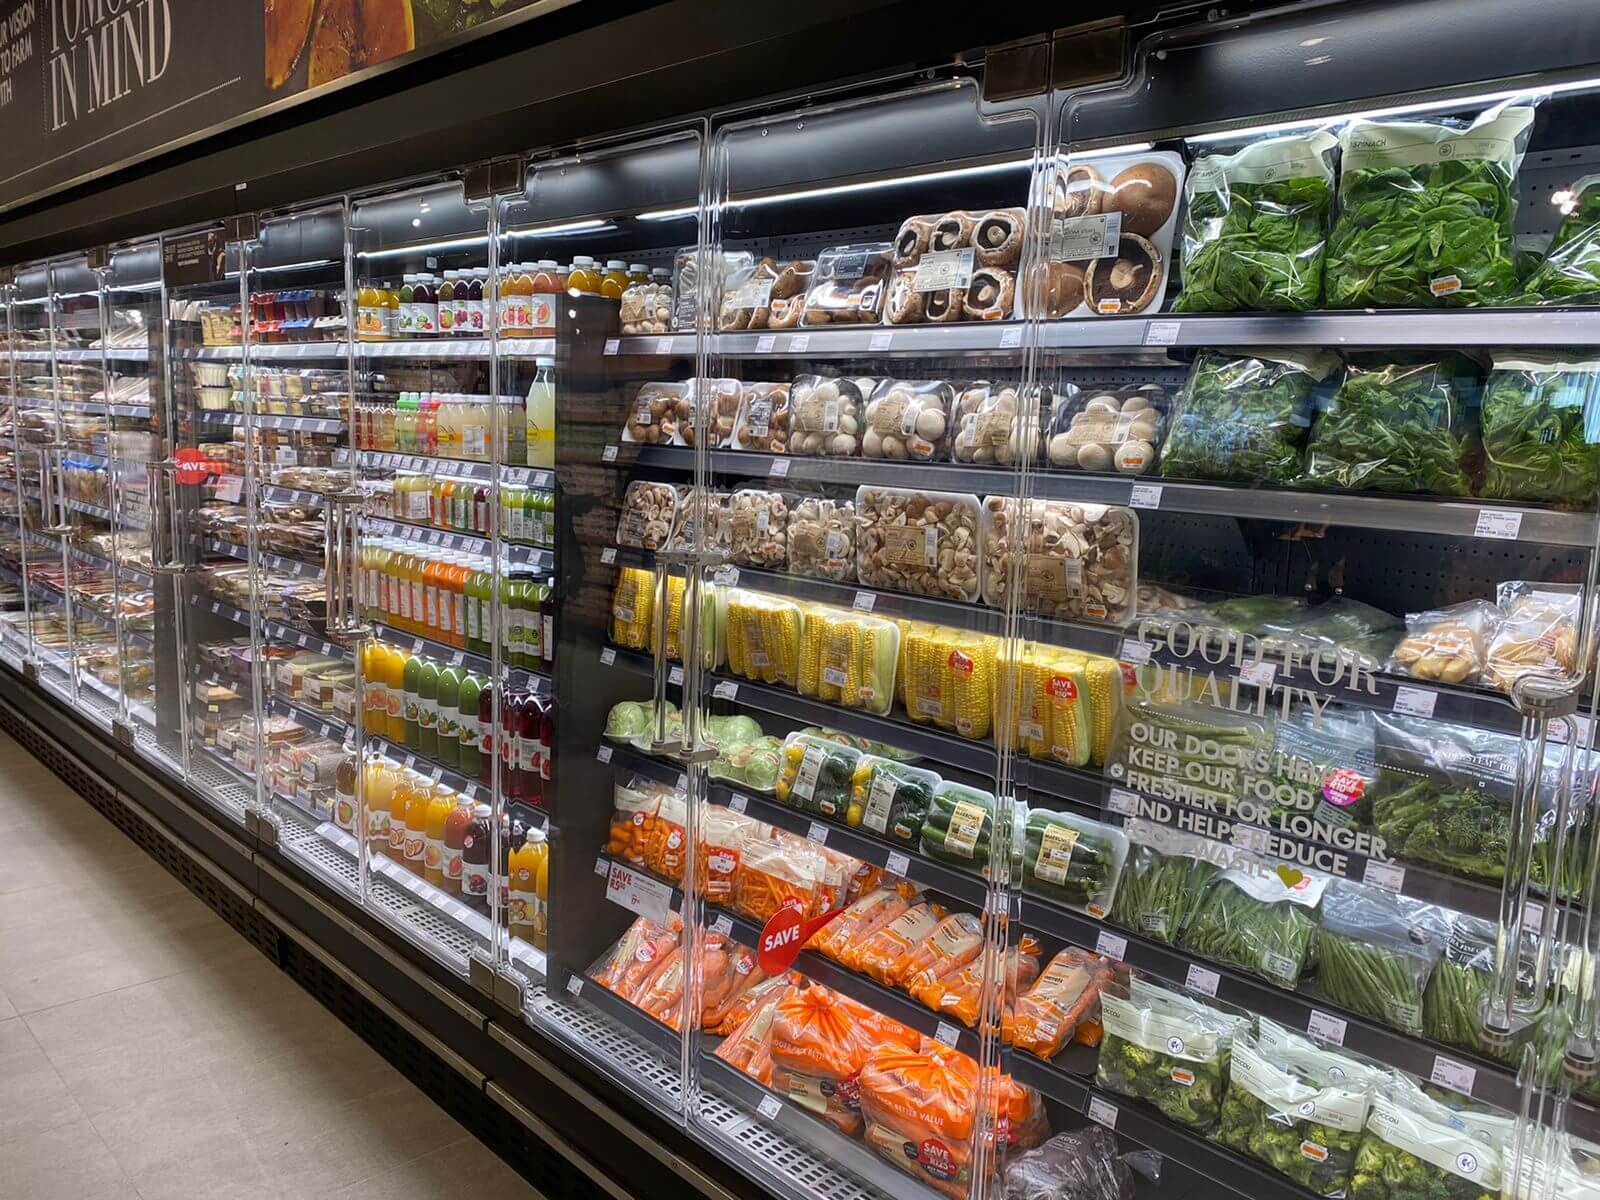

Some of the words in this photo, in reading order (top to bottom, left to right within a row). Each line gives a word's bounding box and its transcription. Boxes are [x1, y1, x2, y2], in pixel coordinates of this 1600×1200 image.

[9, 1, 35, 36] VISION
[1, 50, 11, 76] TO
[12, 31, 33, 70] FARM
[50, 45, 77, 131] IN
[85, 0, 171, 113] MIND
[1137, 620, 1263, 669] GOOD
[1278, 637, 1380, 696] FOR
[1136, 657, 1337, 731] QUALITY
[1130, 723, 1177, 751] OUR
[1185, 738, 1271, 774] DOORS
[1128, 746, 1180, 775] KEEP
[1184, 761, 1236, 791] OUR
[1243, 776, 1314, 811] FOOD
[1126, 770, 1218, 813] FRESHER
[1226, 799, 1272, 829] FOR
[1281, 812, 1397, 866] LONGER,
[1126, 796, 1172, 823] AND
[1178, 808, 1242, 845] HELPS
[1249, 830, 1349, 876] REDUCE
[612, 867, 632, 886] SAVE
[764, 924, 800, 952] SAVE
[920, 1112, 945, 1126] VALUE
[923, 1142, 949, 1160] SAVE
